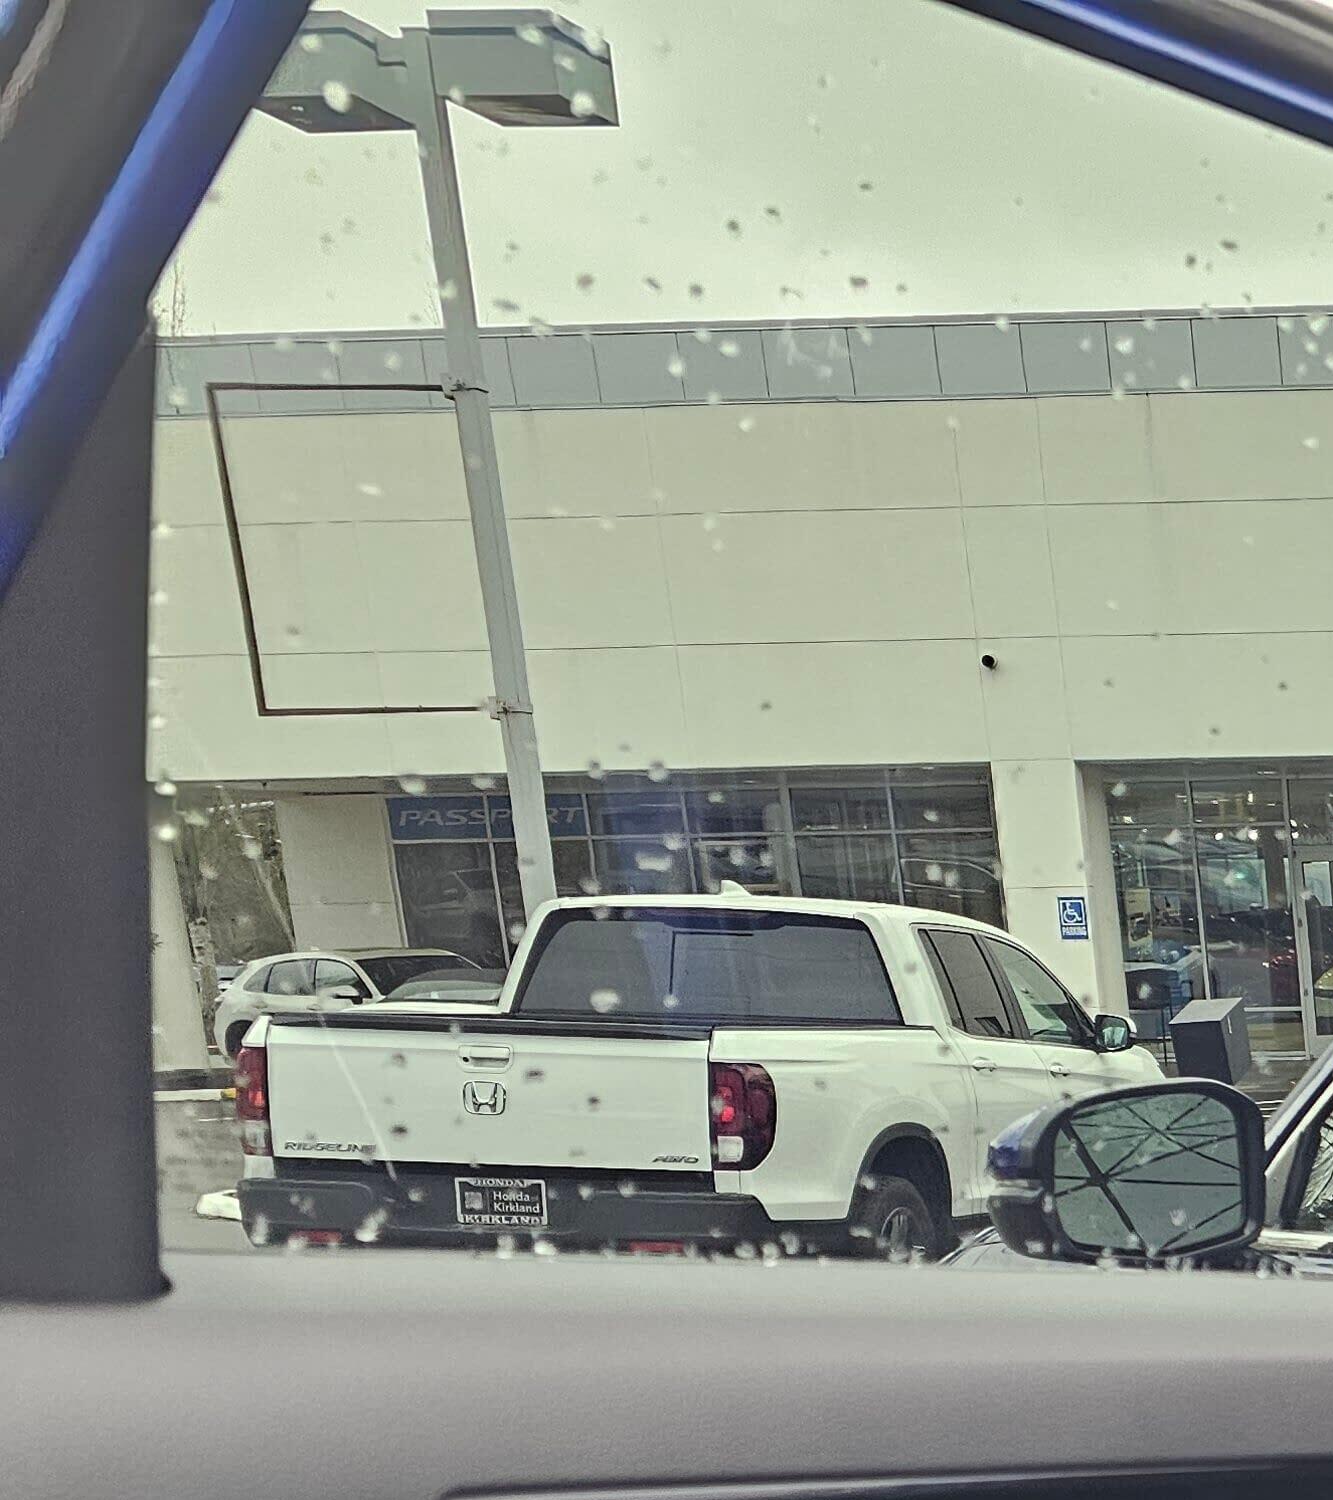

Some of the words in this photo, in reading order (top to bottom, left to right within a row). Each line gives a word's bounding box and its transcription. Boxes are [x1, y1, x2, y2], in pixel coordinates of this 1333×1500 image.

[400, 807, 583, 827] PASSPRT
[284, 1141, 376, 1154] RIDGELIN
[493, 1202, 540, 1214] Kirkland
